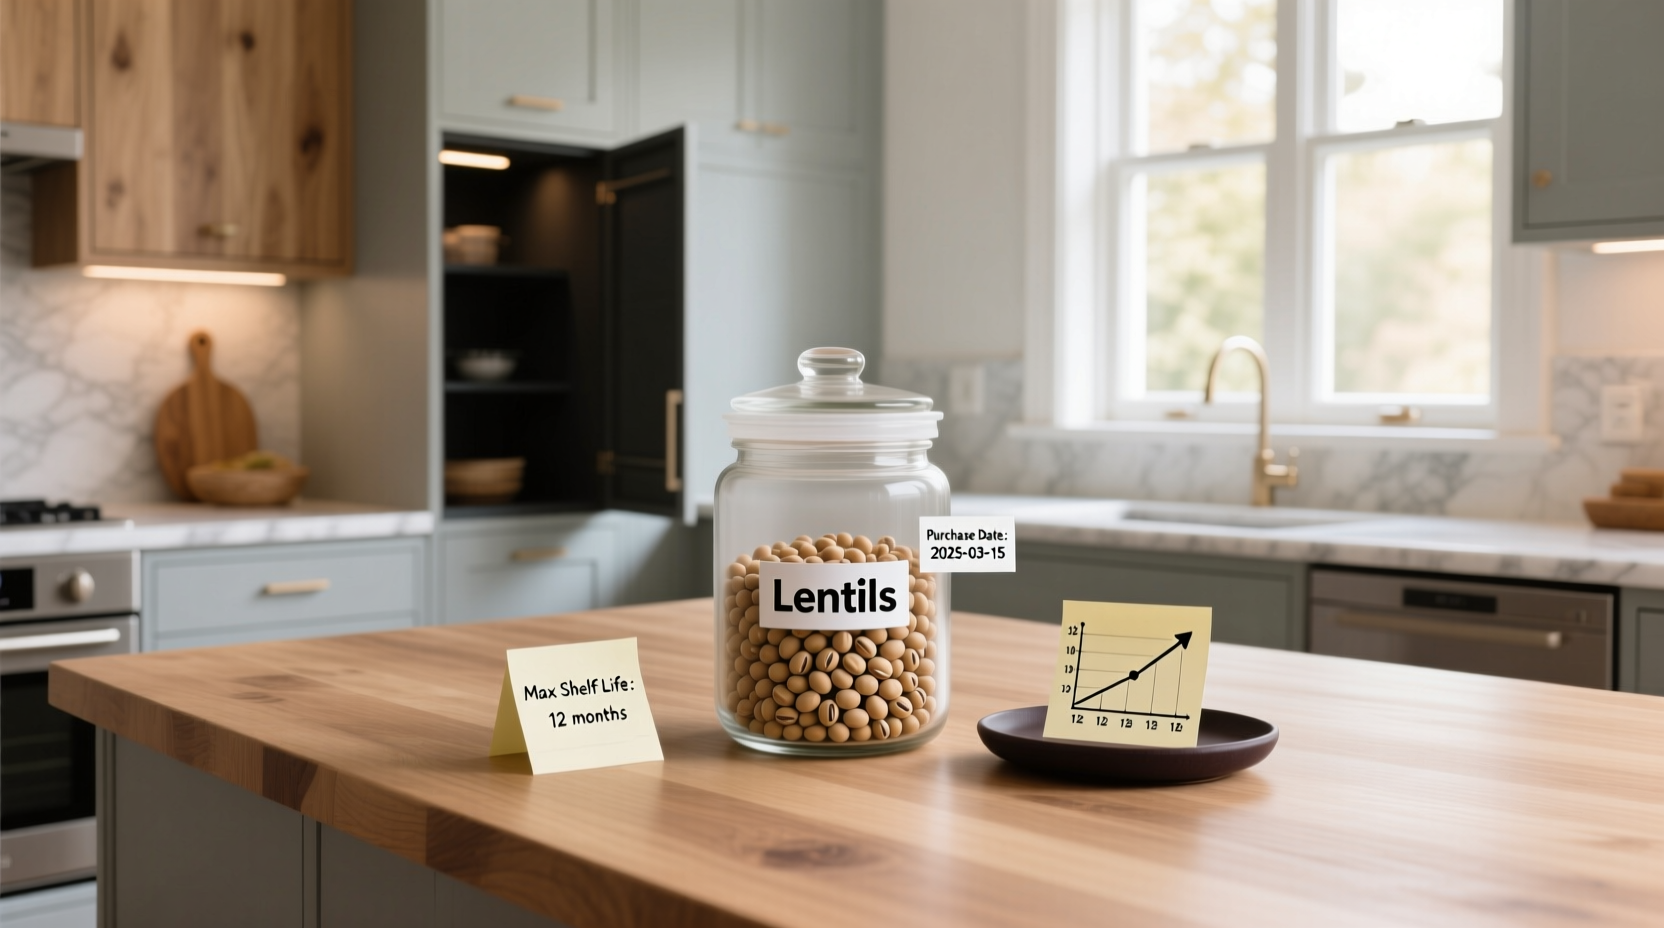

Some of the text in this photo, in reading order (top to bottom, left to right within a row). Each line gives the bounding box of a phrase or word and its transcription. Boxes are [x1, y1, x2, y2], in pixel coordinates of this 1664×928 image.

[926, 528, 1008, 541] Purchase Date:
[930, 546, 1006, 560] 2025-03-15
[773, 577, 897, 614] Lentils
[524, 675, 635, 702] Max Shelf Life:
[548, 704, 628, 729] 12 months
[1071, 714, 1084, 725] 12
